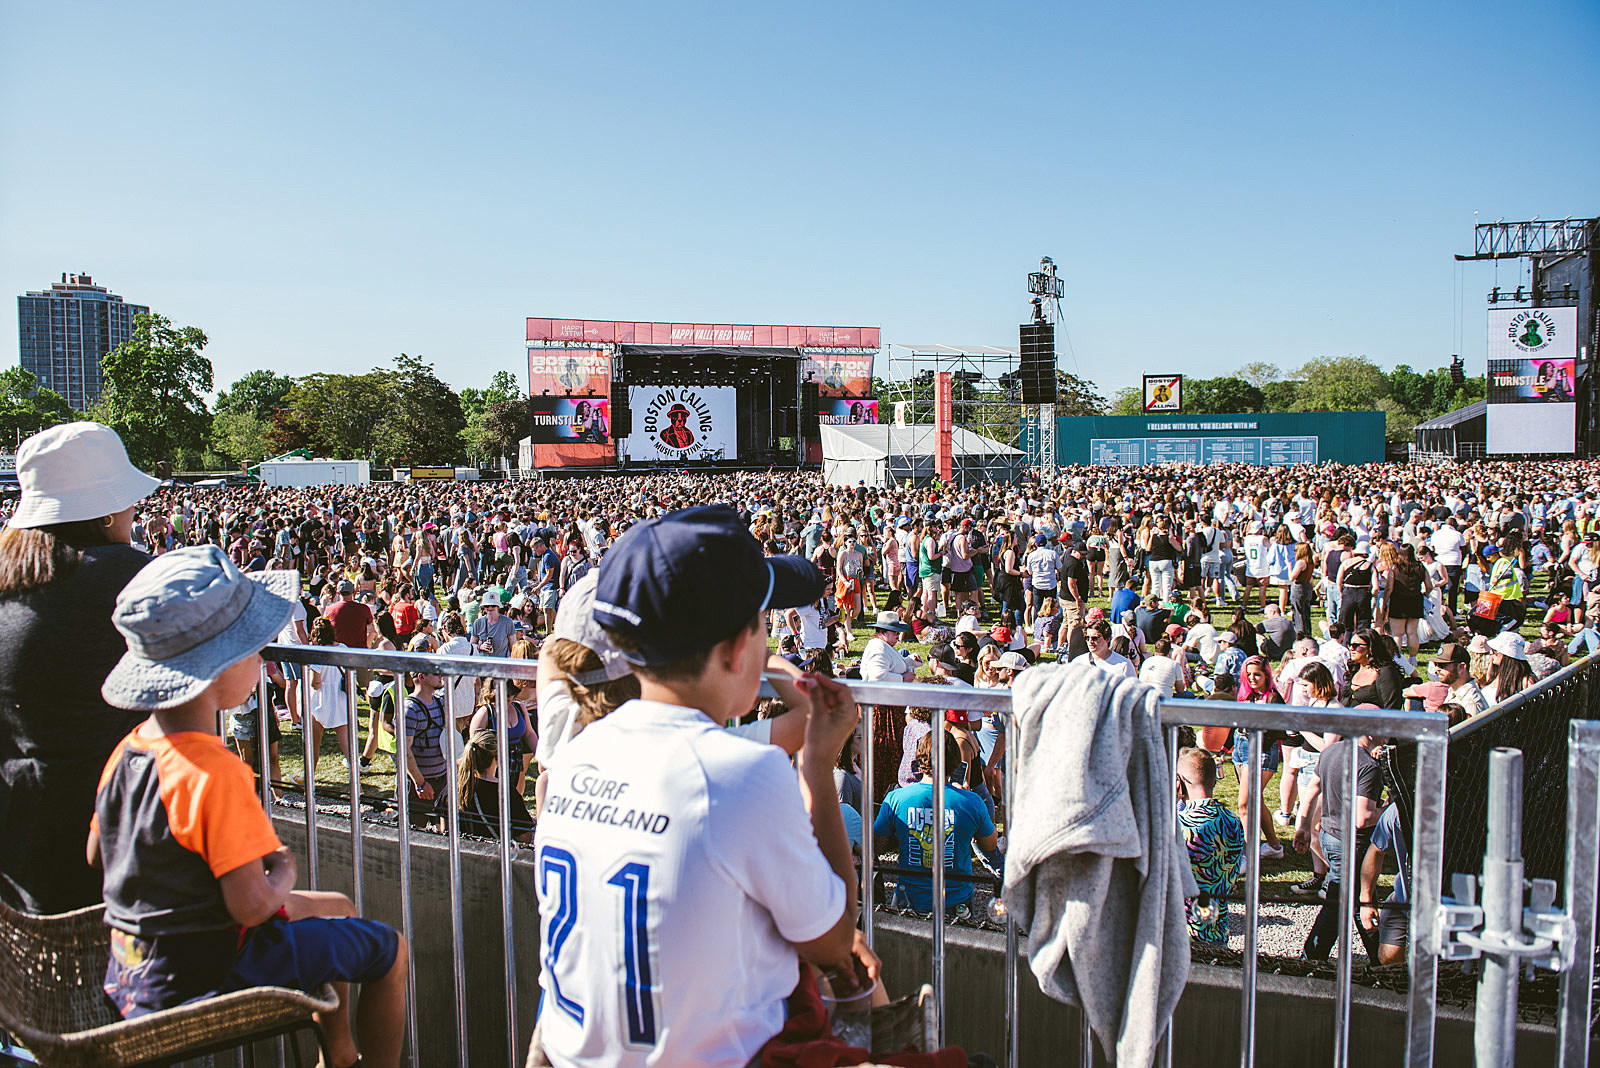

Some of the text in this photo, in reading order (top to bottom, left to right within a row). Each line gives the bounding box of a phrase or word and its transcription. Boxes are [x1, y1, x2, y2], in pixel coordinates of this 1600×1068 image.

[1508, 310, 1556, 338] BOSTON CALLING
[670, 328, 754, 341] HAPPY VALLEY RED STAGE
[532, 356, 609, 367] BOSTON
[532, 366, 609, 375] CALLING
[1493, 375, 1546, 387] TURNSTILE
[644, 388, 713, 433] BOSTON CALLING
[533, 414, 584, 426] TURNSTILE
[818, 414, 857, 425] URNSTILE
[1233, 422, 1248, 430] WITH
[1249, 422, 1258, 430] ME
[653, 441, 704, 458] MUSIC FESTIVAL
[1250, 548, 1258, 560] 0
[571, 770, 630, 800] SURF
[571, 800, 670, 835] ENGLAND
[908, 806, 955, 831] OCEN
[540, 844, 656, 1047] 21
